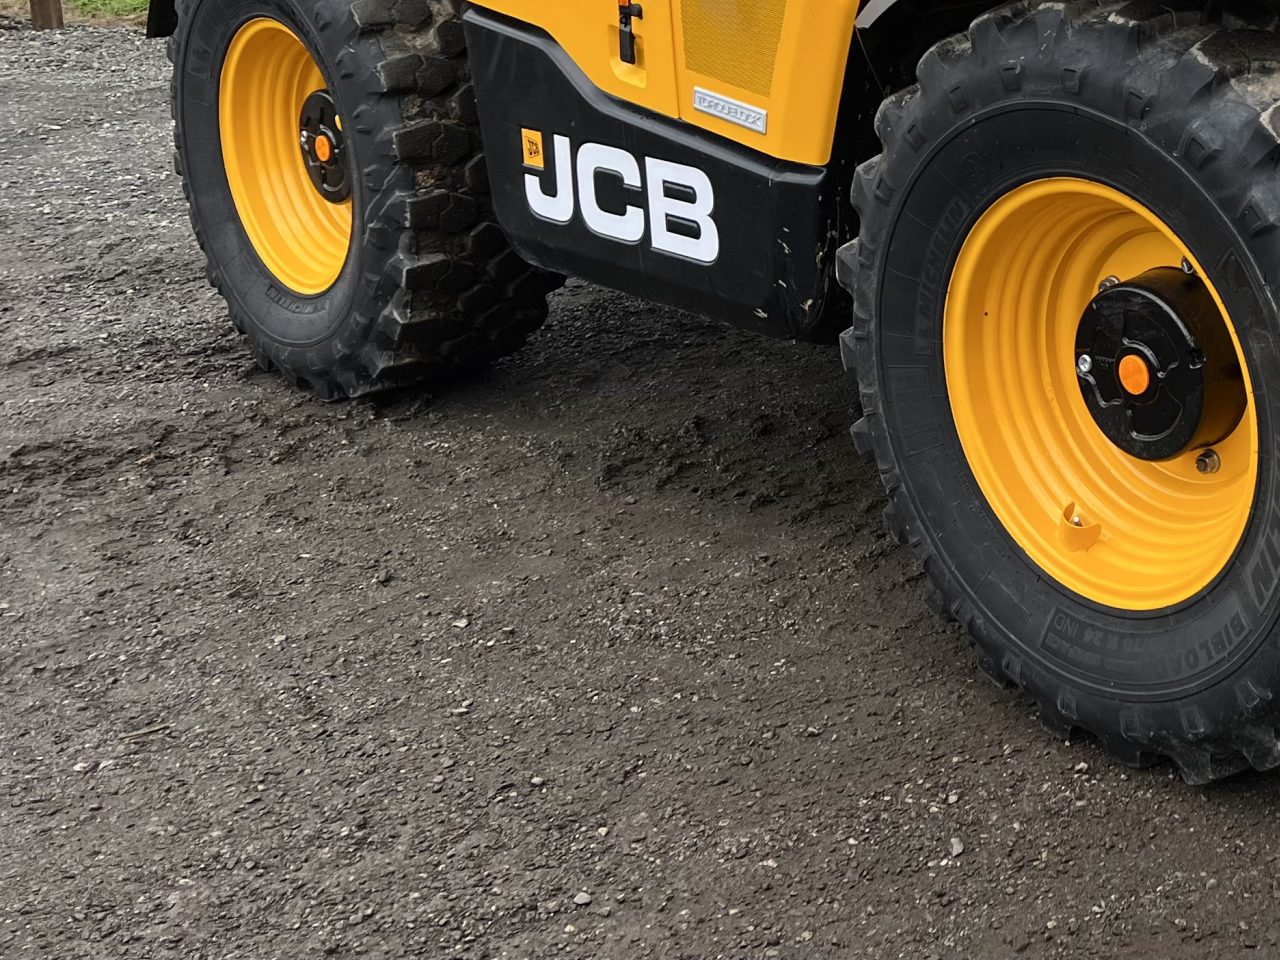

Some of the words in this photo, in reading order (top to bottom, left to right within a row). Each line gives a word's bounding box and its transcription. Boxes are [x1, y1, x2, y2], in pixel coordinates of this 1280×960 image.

[526, 138, 540, 157] JCB
[524, 134, 720, 263] JCB
[1053, 612, 1080, 637] IND
